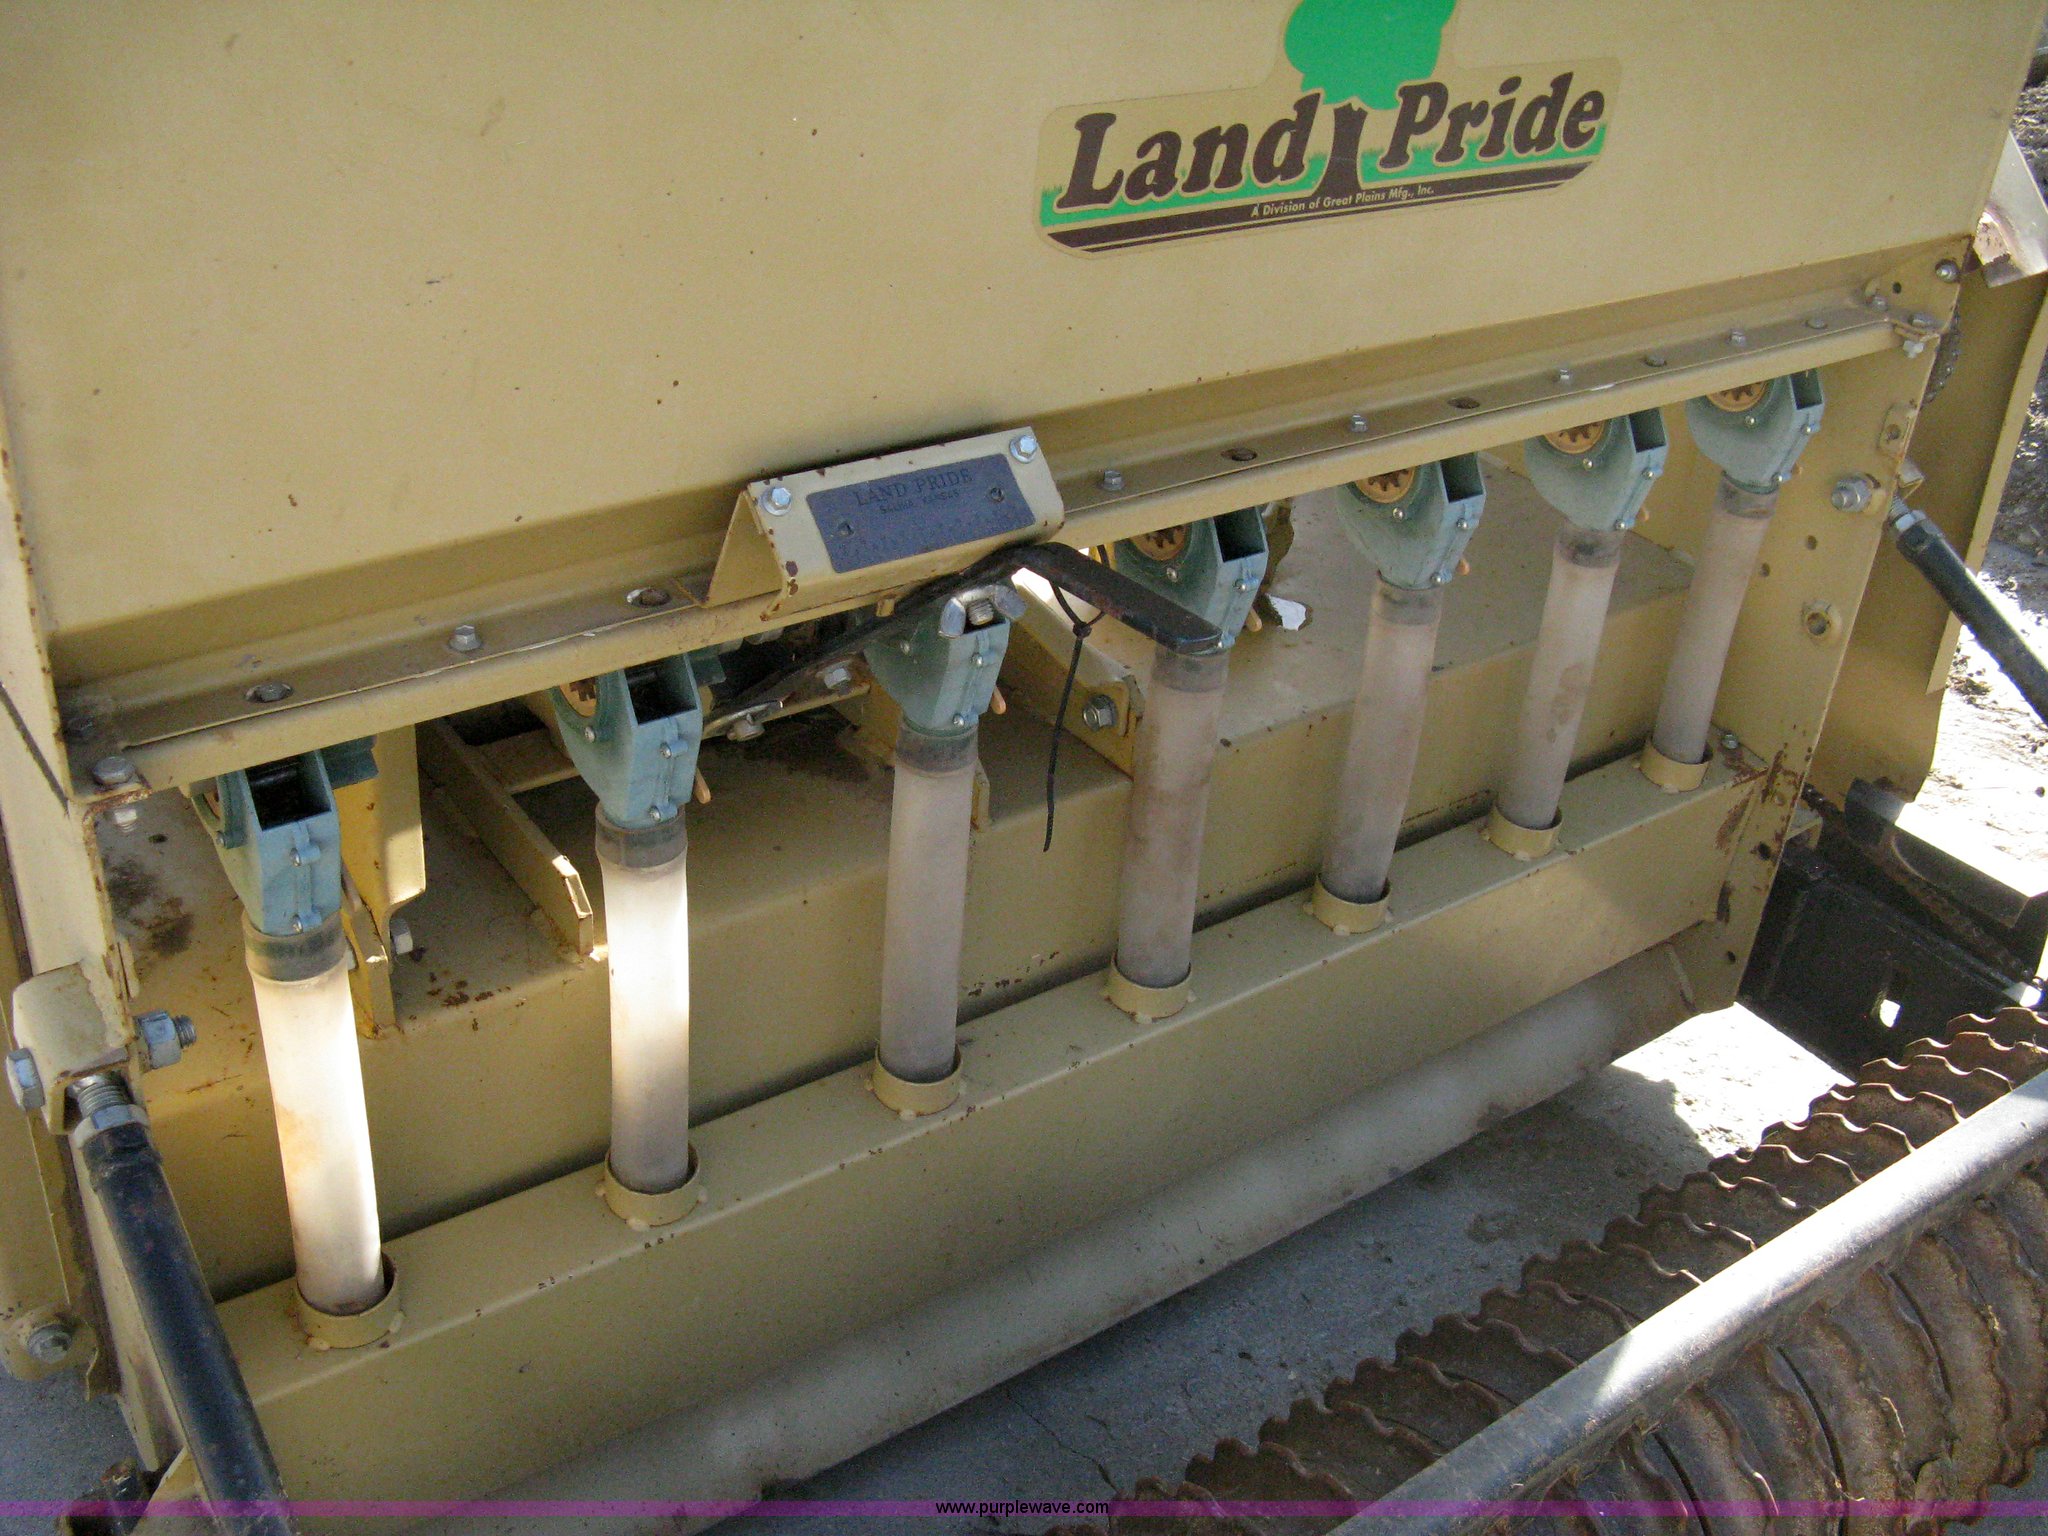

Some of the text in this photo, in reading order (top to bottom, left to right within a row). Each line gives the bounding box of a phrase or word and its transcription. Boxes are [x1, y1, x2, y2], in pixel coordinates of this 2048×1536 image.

[1056, 72, 1606, 209] Land Pride
[1250, 206, 1259, 218] A
[1262, 202, 1305, 216] Division
[1308, 199, 1321, 210] of
[1323, 195, 1353, 209] Great
[1355, 192, 1386, 203] Plains
[1417, 184, 1435, 195] Inc.
[853, 469, 972, 505] LAND PRIDE
